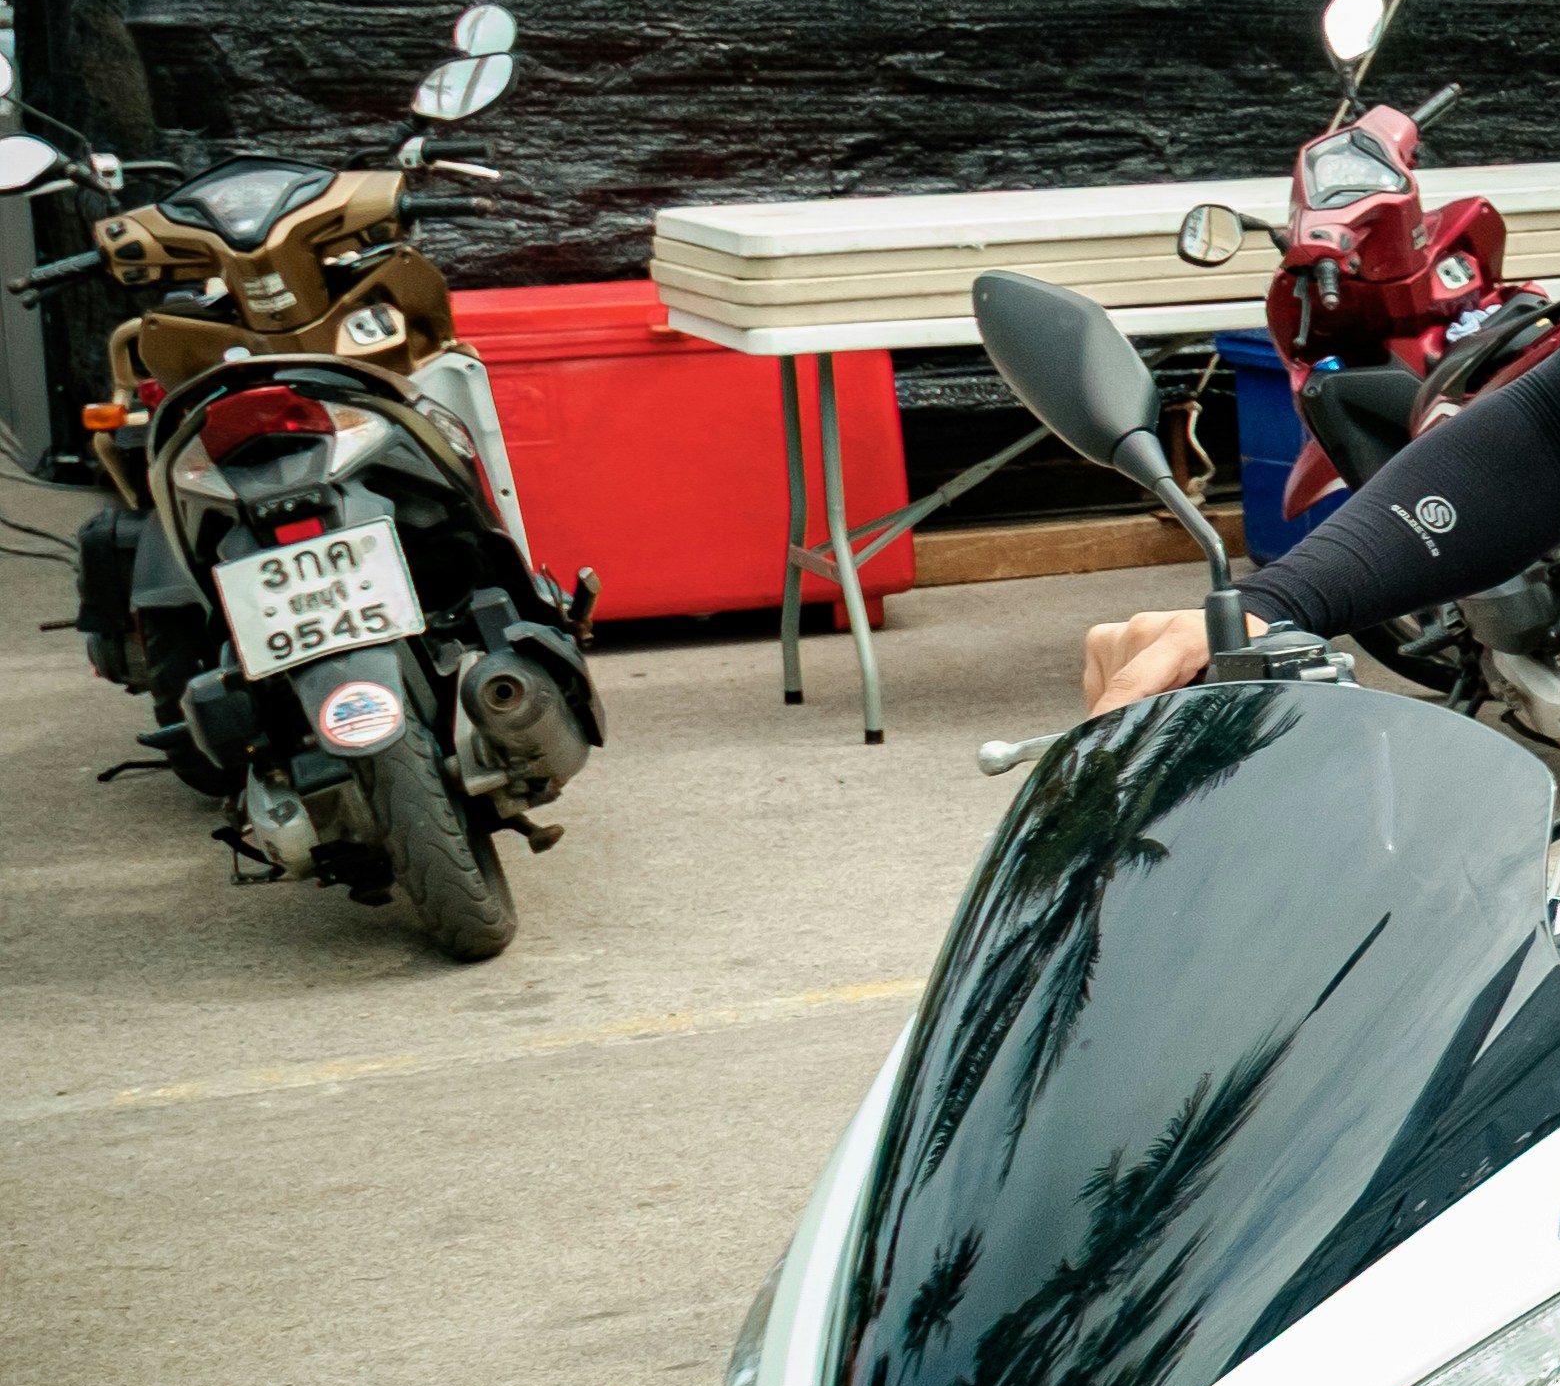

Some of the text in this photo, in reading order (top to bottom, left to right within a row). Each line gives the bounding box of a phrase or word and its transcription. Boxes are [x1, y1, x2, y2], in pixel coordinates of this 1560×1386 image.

[288, 579, 349, 616] ชลบุรี
[266, 602, 391, 661] 9545
